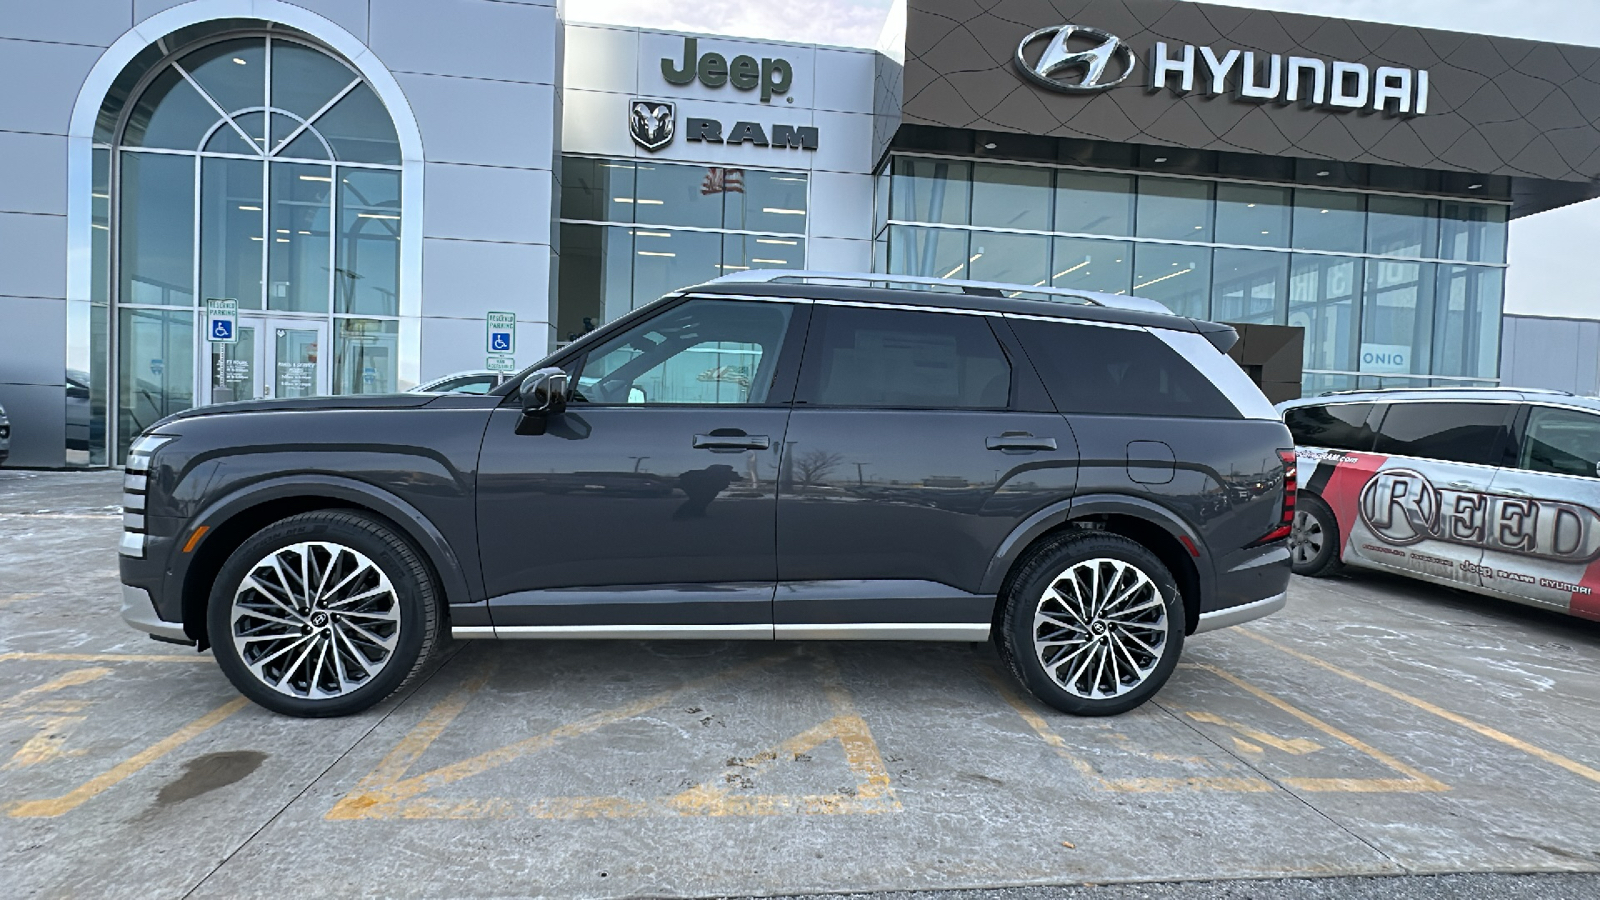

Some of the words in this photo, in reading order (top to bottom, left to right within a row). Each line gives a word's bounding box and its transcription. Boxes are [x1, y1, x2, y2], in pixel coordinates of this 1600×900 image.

[661, 38, 792, 102] Jeep
[1150, 42, 1428, 115] HYUNDAI
[687, 117, 819, 150] RAM
[1363, 470, 1600, 561] REED
[1460, 560, 1492, 579] Jeep
[1497, 570, 1535, 585] RAM
[1540, 577, 1592, 596] HYUNDAI
